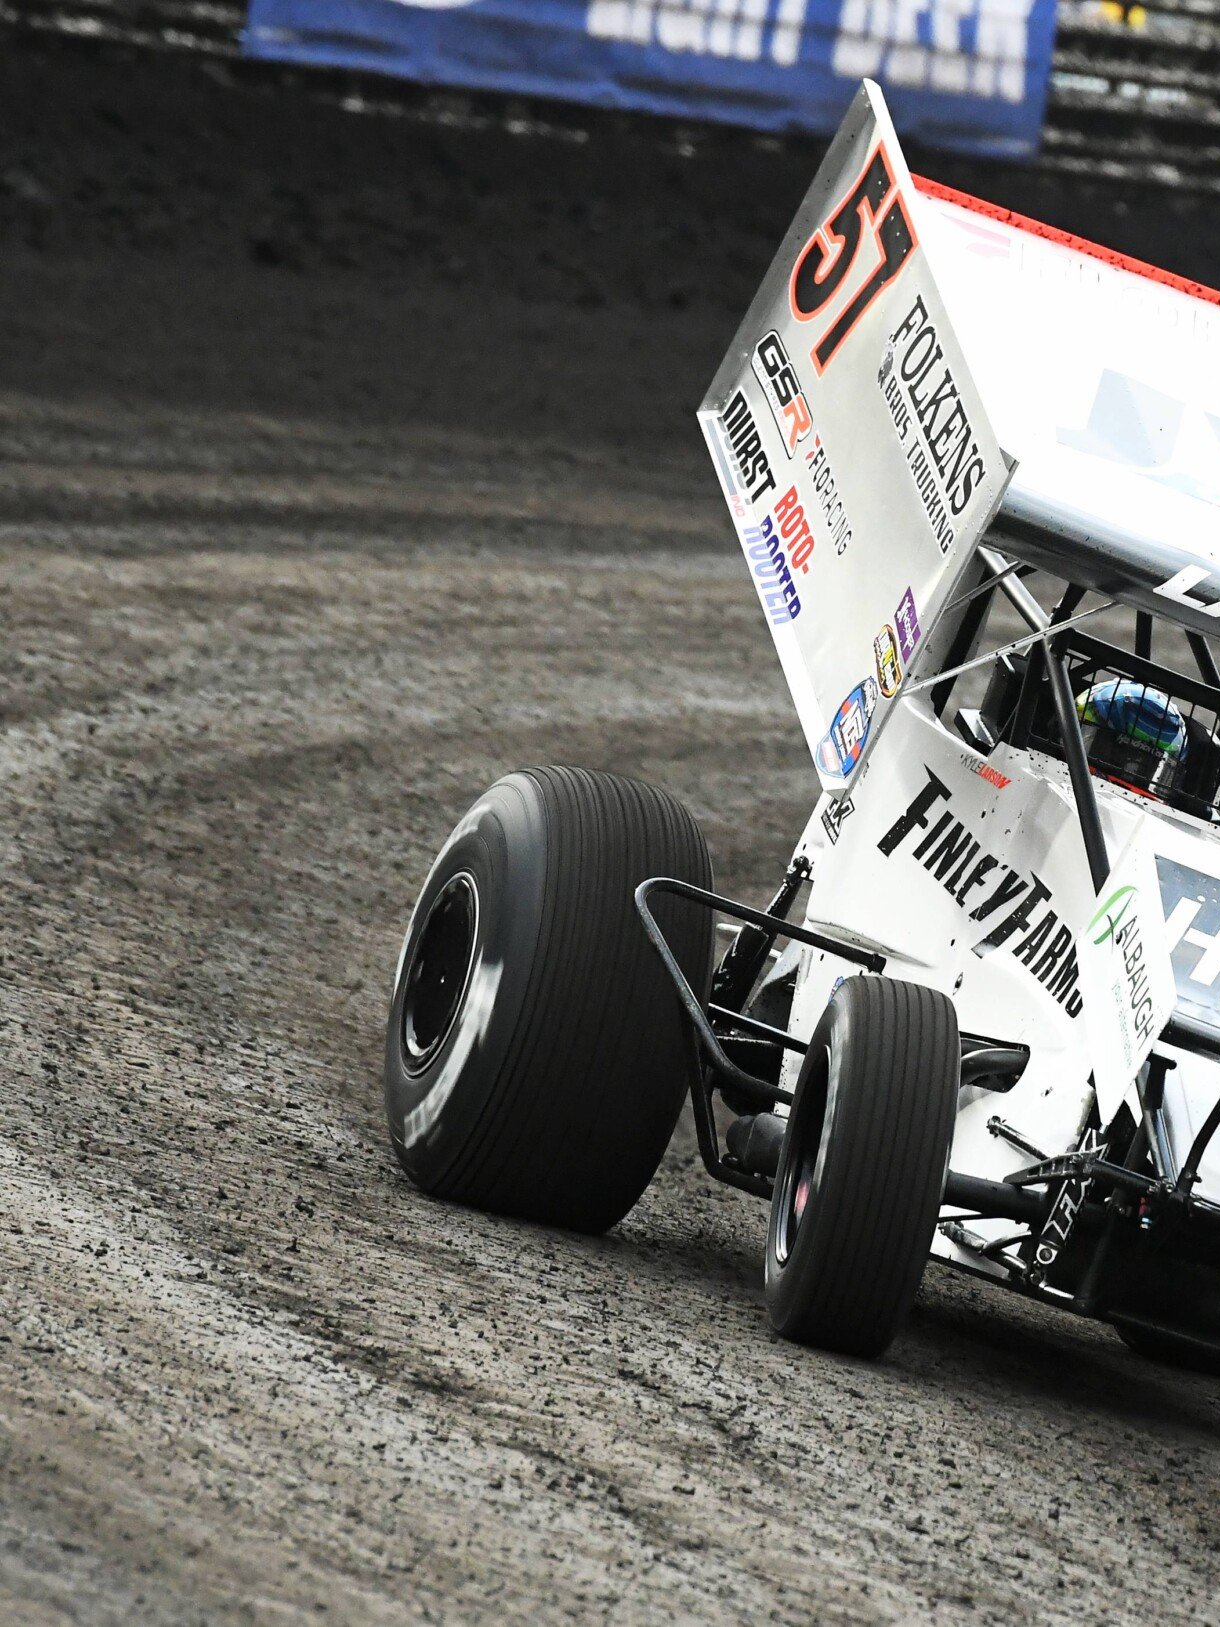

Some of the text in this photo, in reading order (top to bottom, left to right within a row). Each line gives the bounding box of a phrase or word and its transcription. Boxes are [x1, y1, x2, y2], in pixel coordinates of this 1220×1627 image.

[789, 138, 919, 379] 57
[717, 390, 776, 505] DURST
[757, 333, 811, 450] GSR
[890, 293, 987, 517] FOLKENS
[774, 485, 815, 574] ROTO-
[905, 434, 955, 555] TRUCKING
[743, 515, 801, 624] ROOTER
[877, 764, 1028, 921] FINLEY
[1117, 915, 1155, 1051] ALBAUGH
